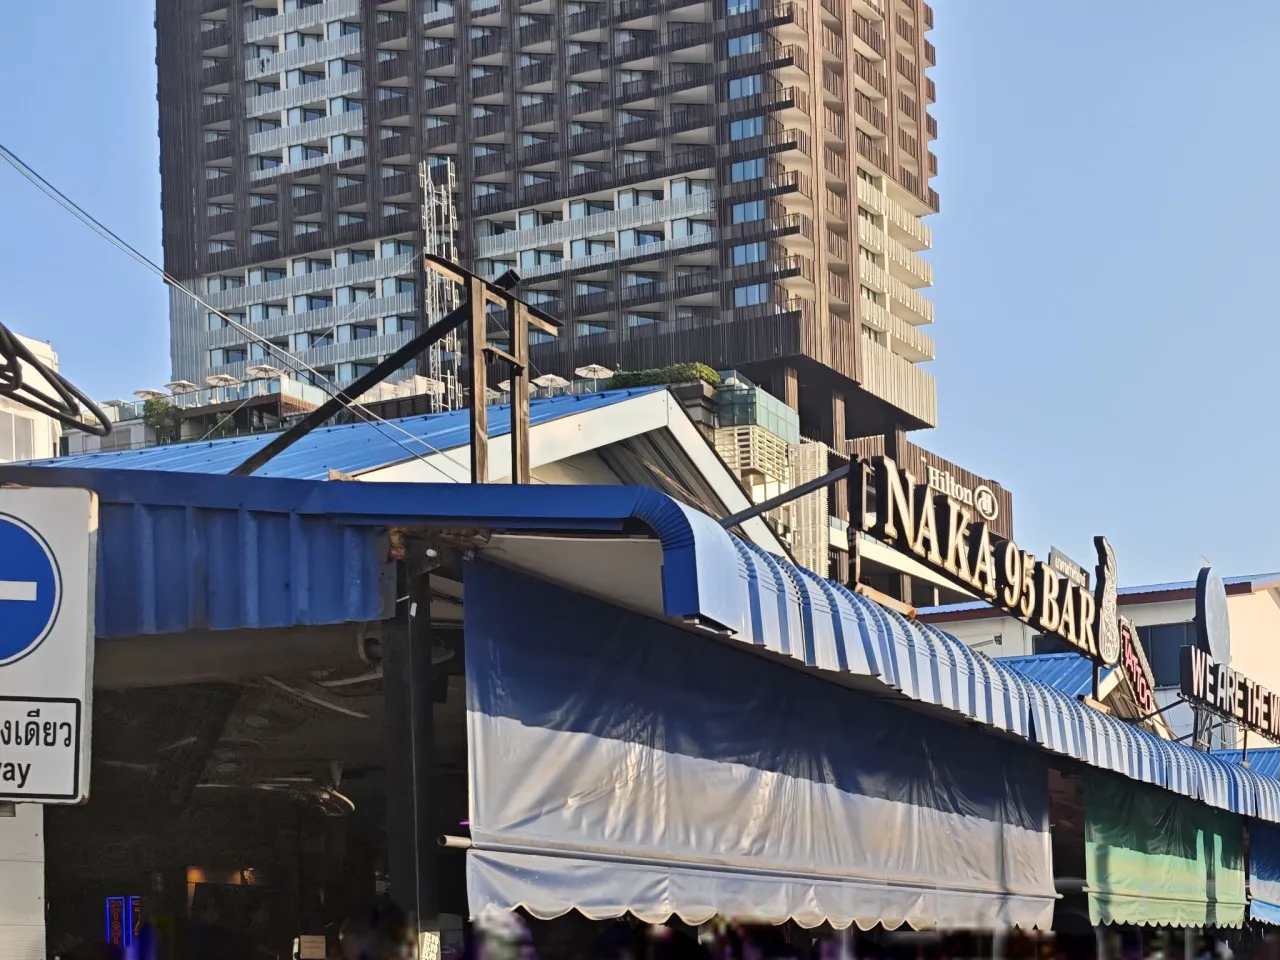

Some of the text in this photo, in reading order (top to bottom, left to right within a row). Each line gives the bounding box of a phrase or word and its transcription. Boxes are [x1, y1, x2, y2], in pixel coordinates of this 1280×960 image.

[928, 465, 974, 506] Hilton
[884, 457, 1098, 656] NAKA 95 BAR
[1122, 628, 1152, 716] TATTOO
[1191, 645, 1215, 705] WE
[1216, 663, 1245, 719] ARE
[1245, 677, 1269, 731] THE
[0, 761, 32, 789] ay
